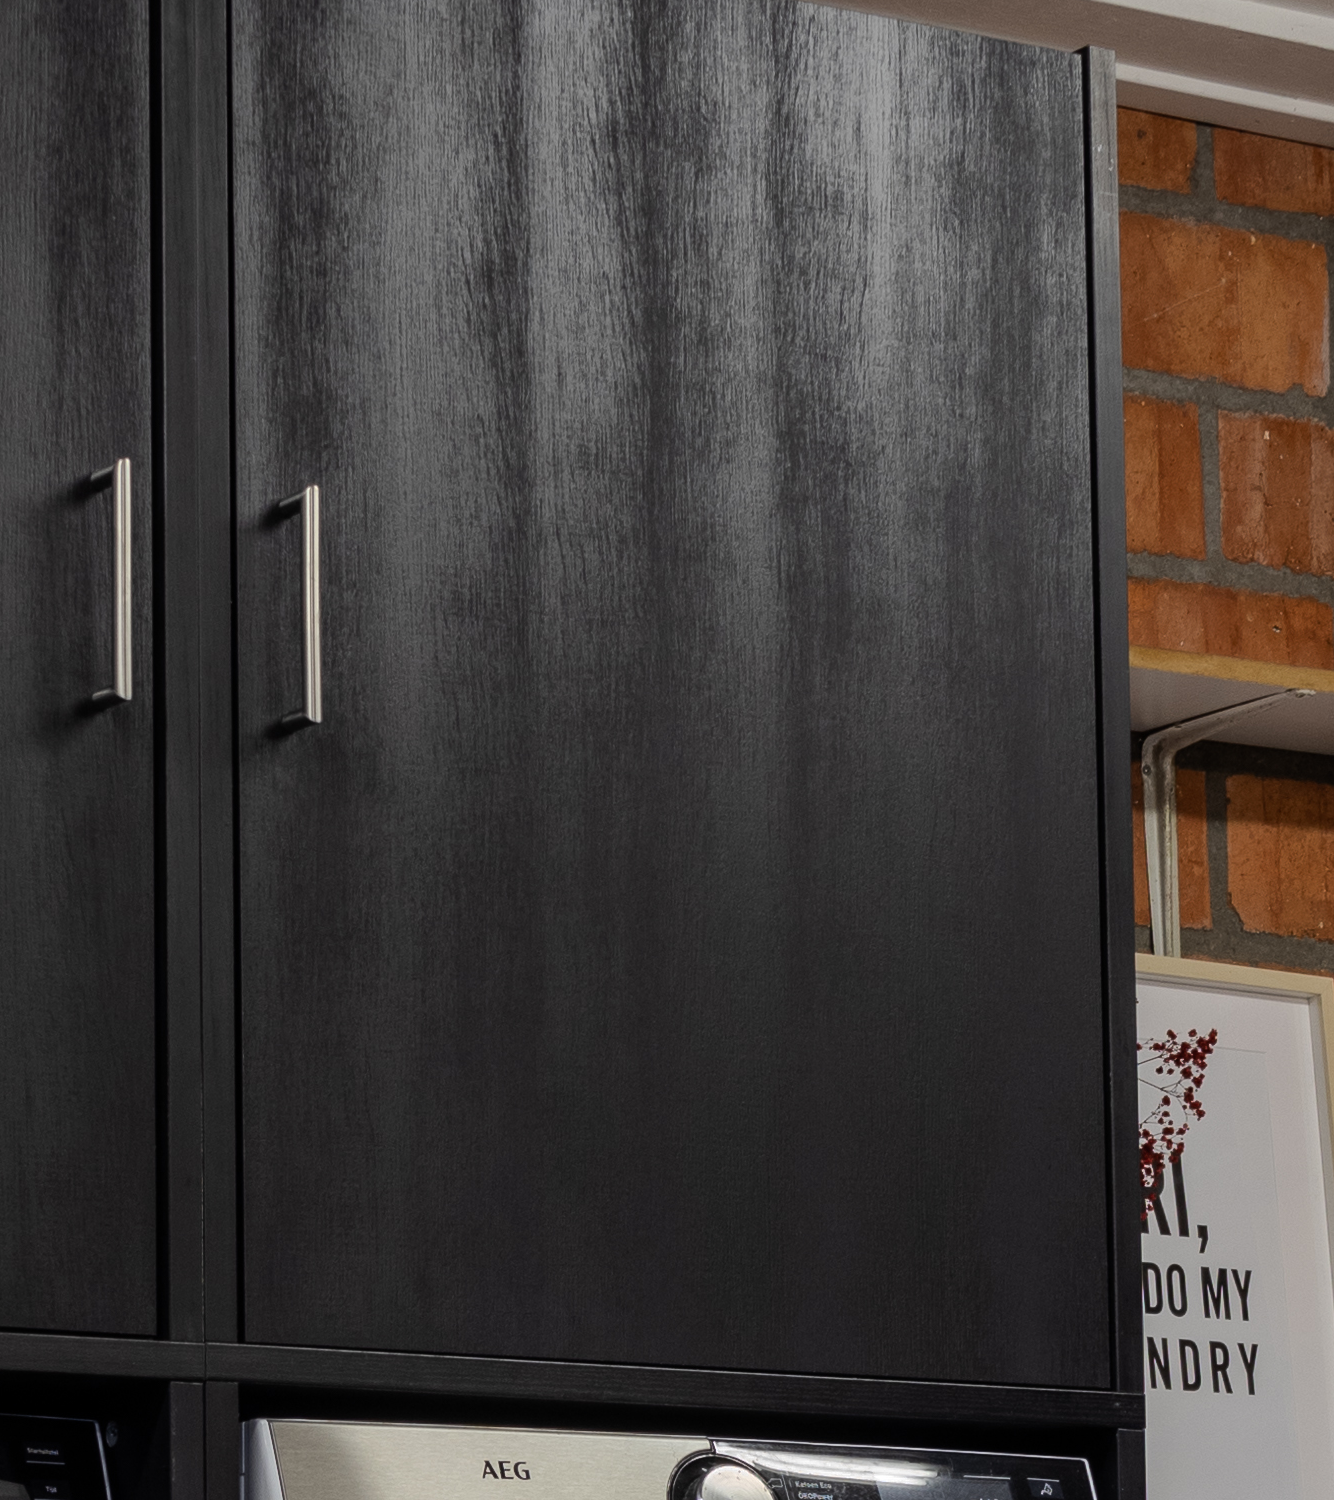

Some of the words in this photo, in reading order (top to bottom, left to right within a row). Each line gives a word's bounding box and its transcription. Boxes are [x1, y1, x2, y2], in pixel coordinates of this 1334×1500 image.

[1142, 1262, 1188, 1317] DO
[1200, 1266, 1252, 1322] MY
[482, 1460, 531, 1480] AEG
